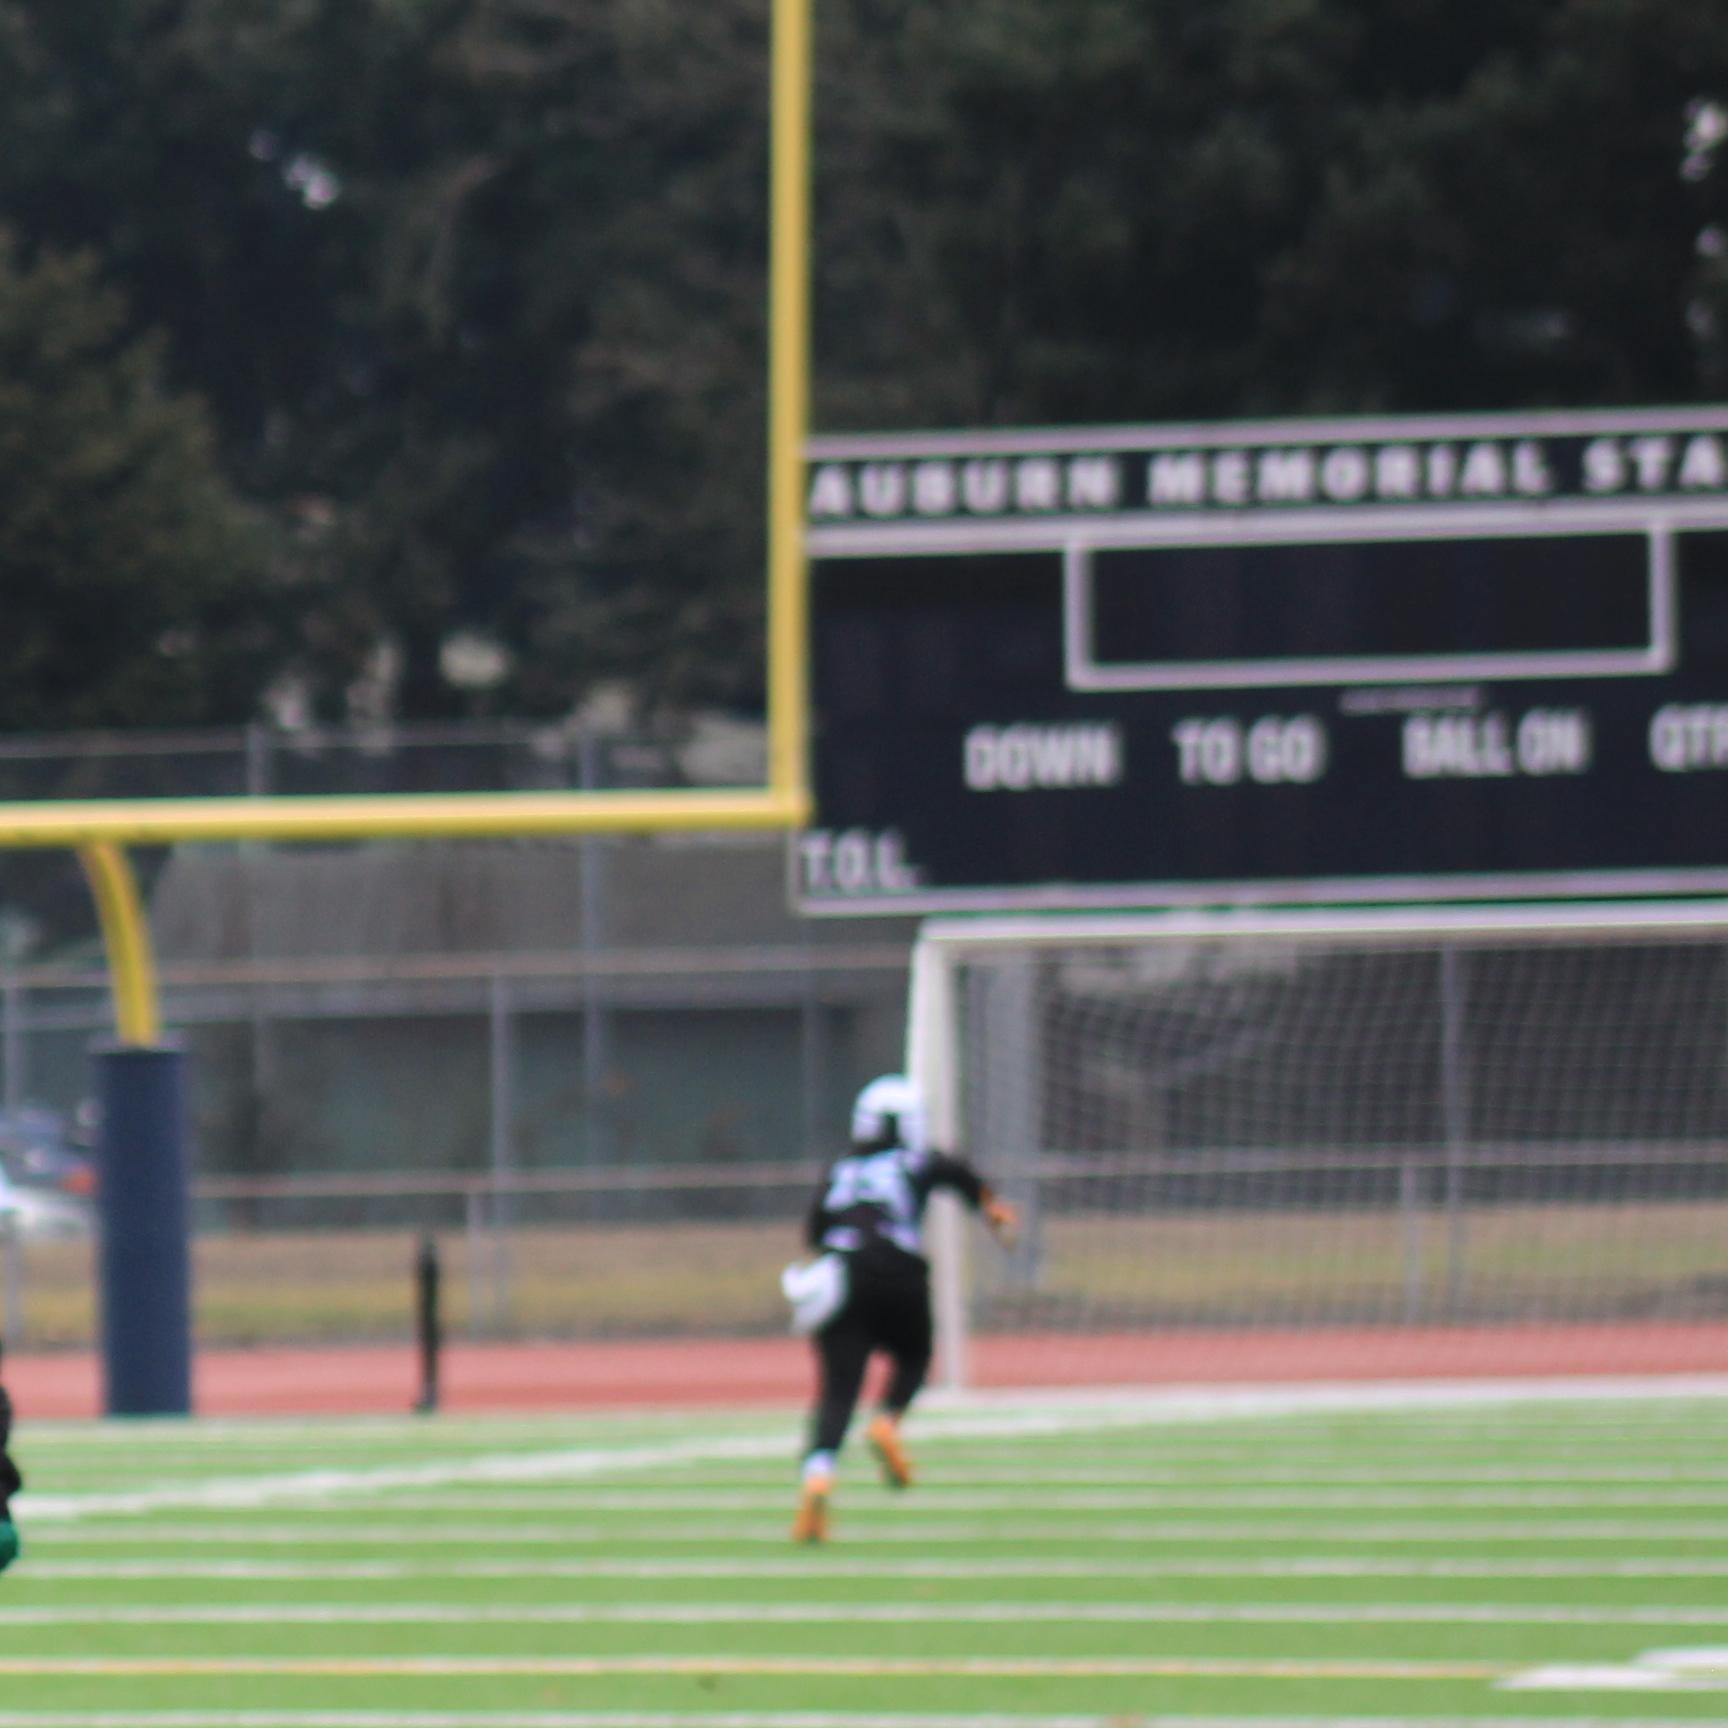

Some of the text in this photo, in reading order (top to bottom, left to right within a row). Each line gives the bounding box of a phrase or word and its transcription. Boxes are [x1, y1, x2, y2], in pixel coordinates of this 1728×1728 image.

[807, 435, 1724, 517] AUBURN MEMORIAL STA
[964, 724, 1123, 792] DOWN
[1172, 718, 1244, 785] TO
[1247, 715, 1327, 784] GO
[1402, 716, 1516, 779] BALL
[1516, 709, 1592, 776] ON
